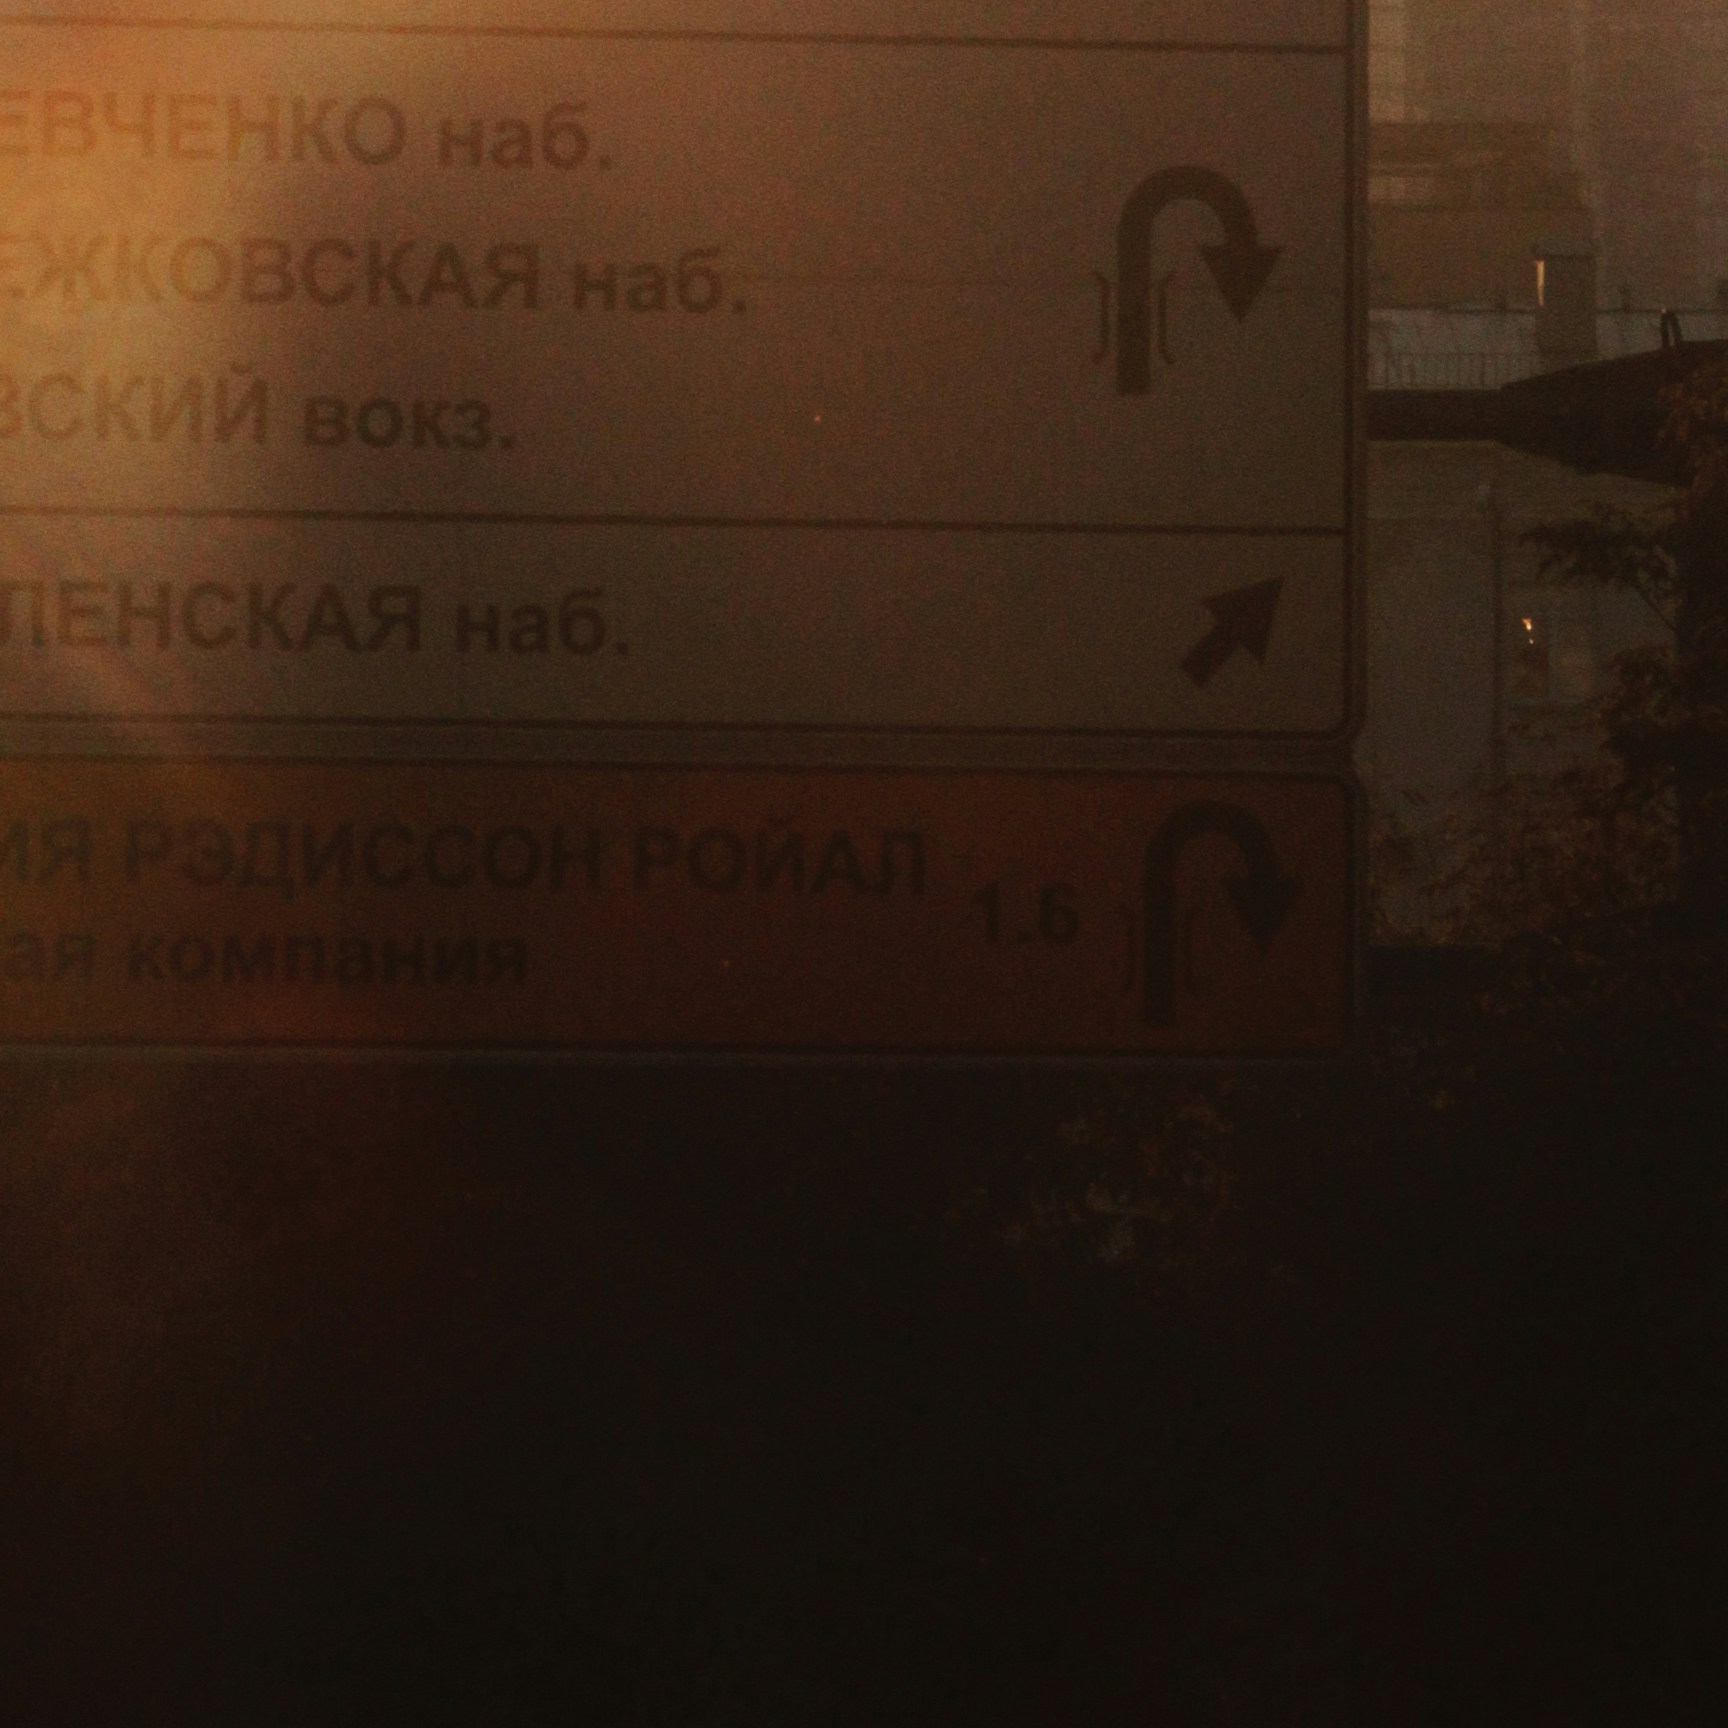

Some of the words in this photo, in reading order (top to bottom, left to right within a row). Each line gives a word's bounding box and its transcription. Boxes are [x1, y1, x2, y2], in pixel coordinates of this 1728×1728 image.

[0, 89, 407, 166] ЕВЧЕНКО
[438, 101, 612, 171] наб.
[571, 246, 747, 316] наб.
[303, 395, 517, 451] вокз.
[0, 580, 423, 654] ЛЕНСКАЯ
[453, 588, 629, 657] наб.
[122, 820, 601, 899] РЭДИССОН
[633, 814, 927, 897] РОЙАЛ
[969, 881, 1080, 945] 1.6
[126, 931, 529, 985] компания
